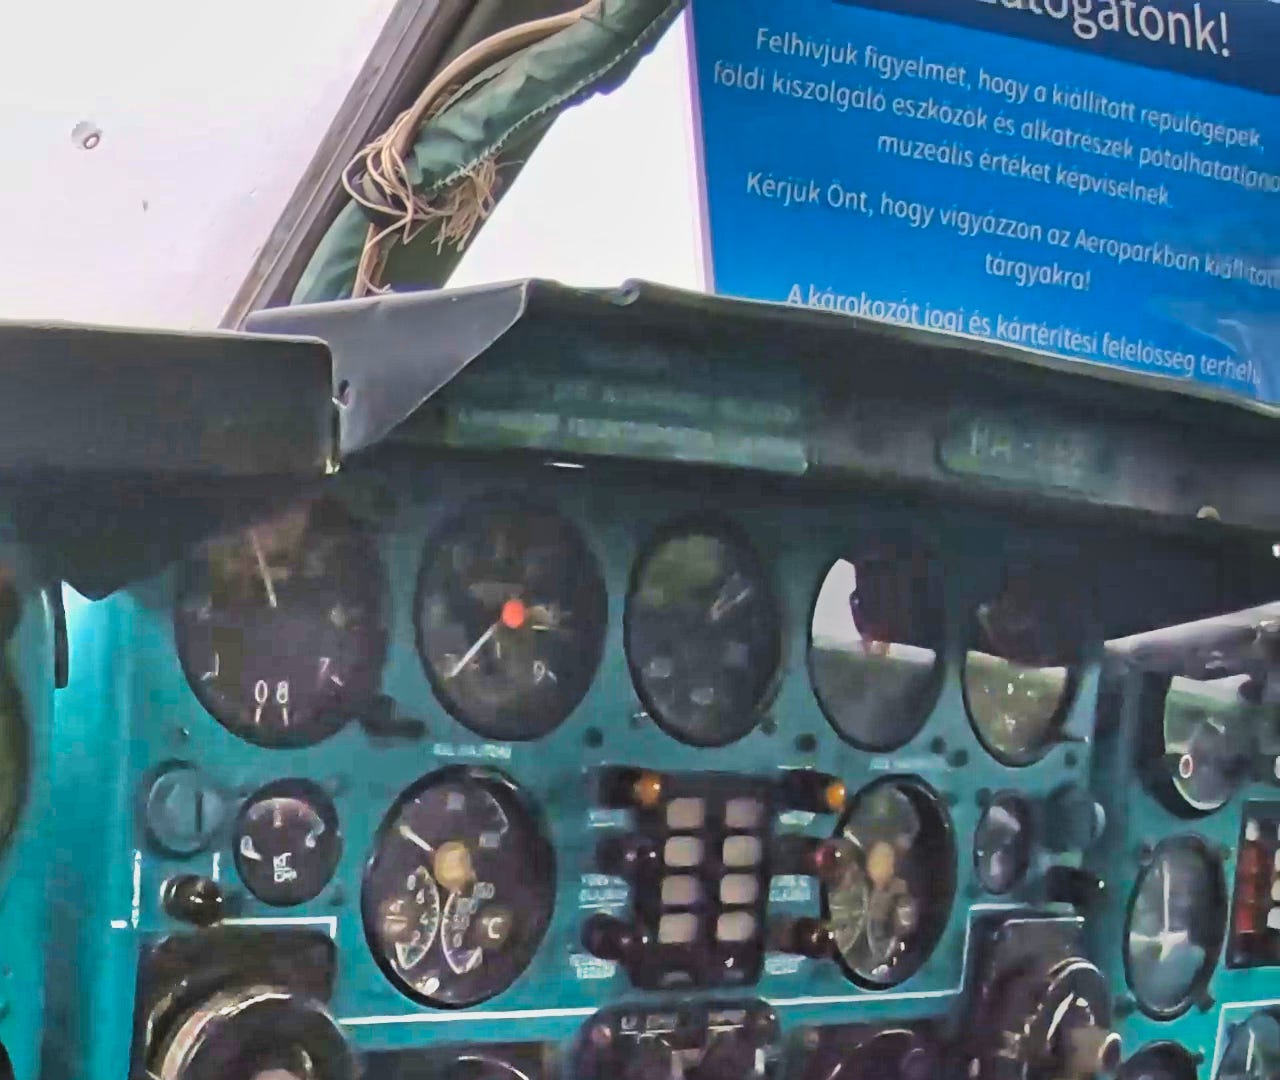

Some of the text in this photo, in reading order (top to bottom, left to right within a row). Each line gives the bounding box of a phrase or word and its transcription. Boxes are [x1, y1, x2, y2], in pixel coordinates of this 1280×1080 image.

[714, 60, 764, 91] földi
[773, 72, 886, 112] kiszolgáló
[892, 97, 987, 130] eszközök
[994, 110, 1015, 136] és
[1022, 118, 1134, 160] alkatrészek
[979, 67, 1029, 104] hogy
[1034, 85, 1046, 103] a
[980, 146, 1050, 184] értéket
[747, 172, 820, 206] Kérjük
[827, 180, 874, 218] Önt,
[881, 193, 935, 229] hogy
[940, 204, 1041, 242] vigyázzon
[1048, 229, 1070, 248] az
[1074, 229, 1199, 272] Aeroparkban
[986, 251, 1090, 291] tárgyakra!
[788, 284, 804, 304] A
[809, 284, 919, 324] károkozót
[969, 309, 990, 334] és
[997, 313, 1097, 355] kártérítési
